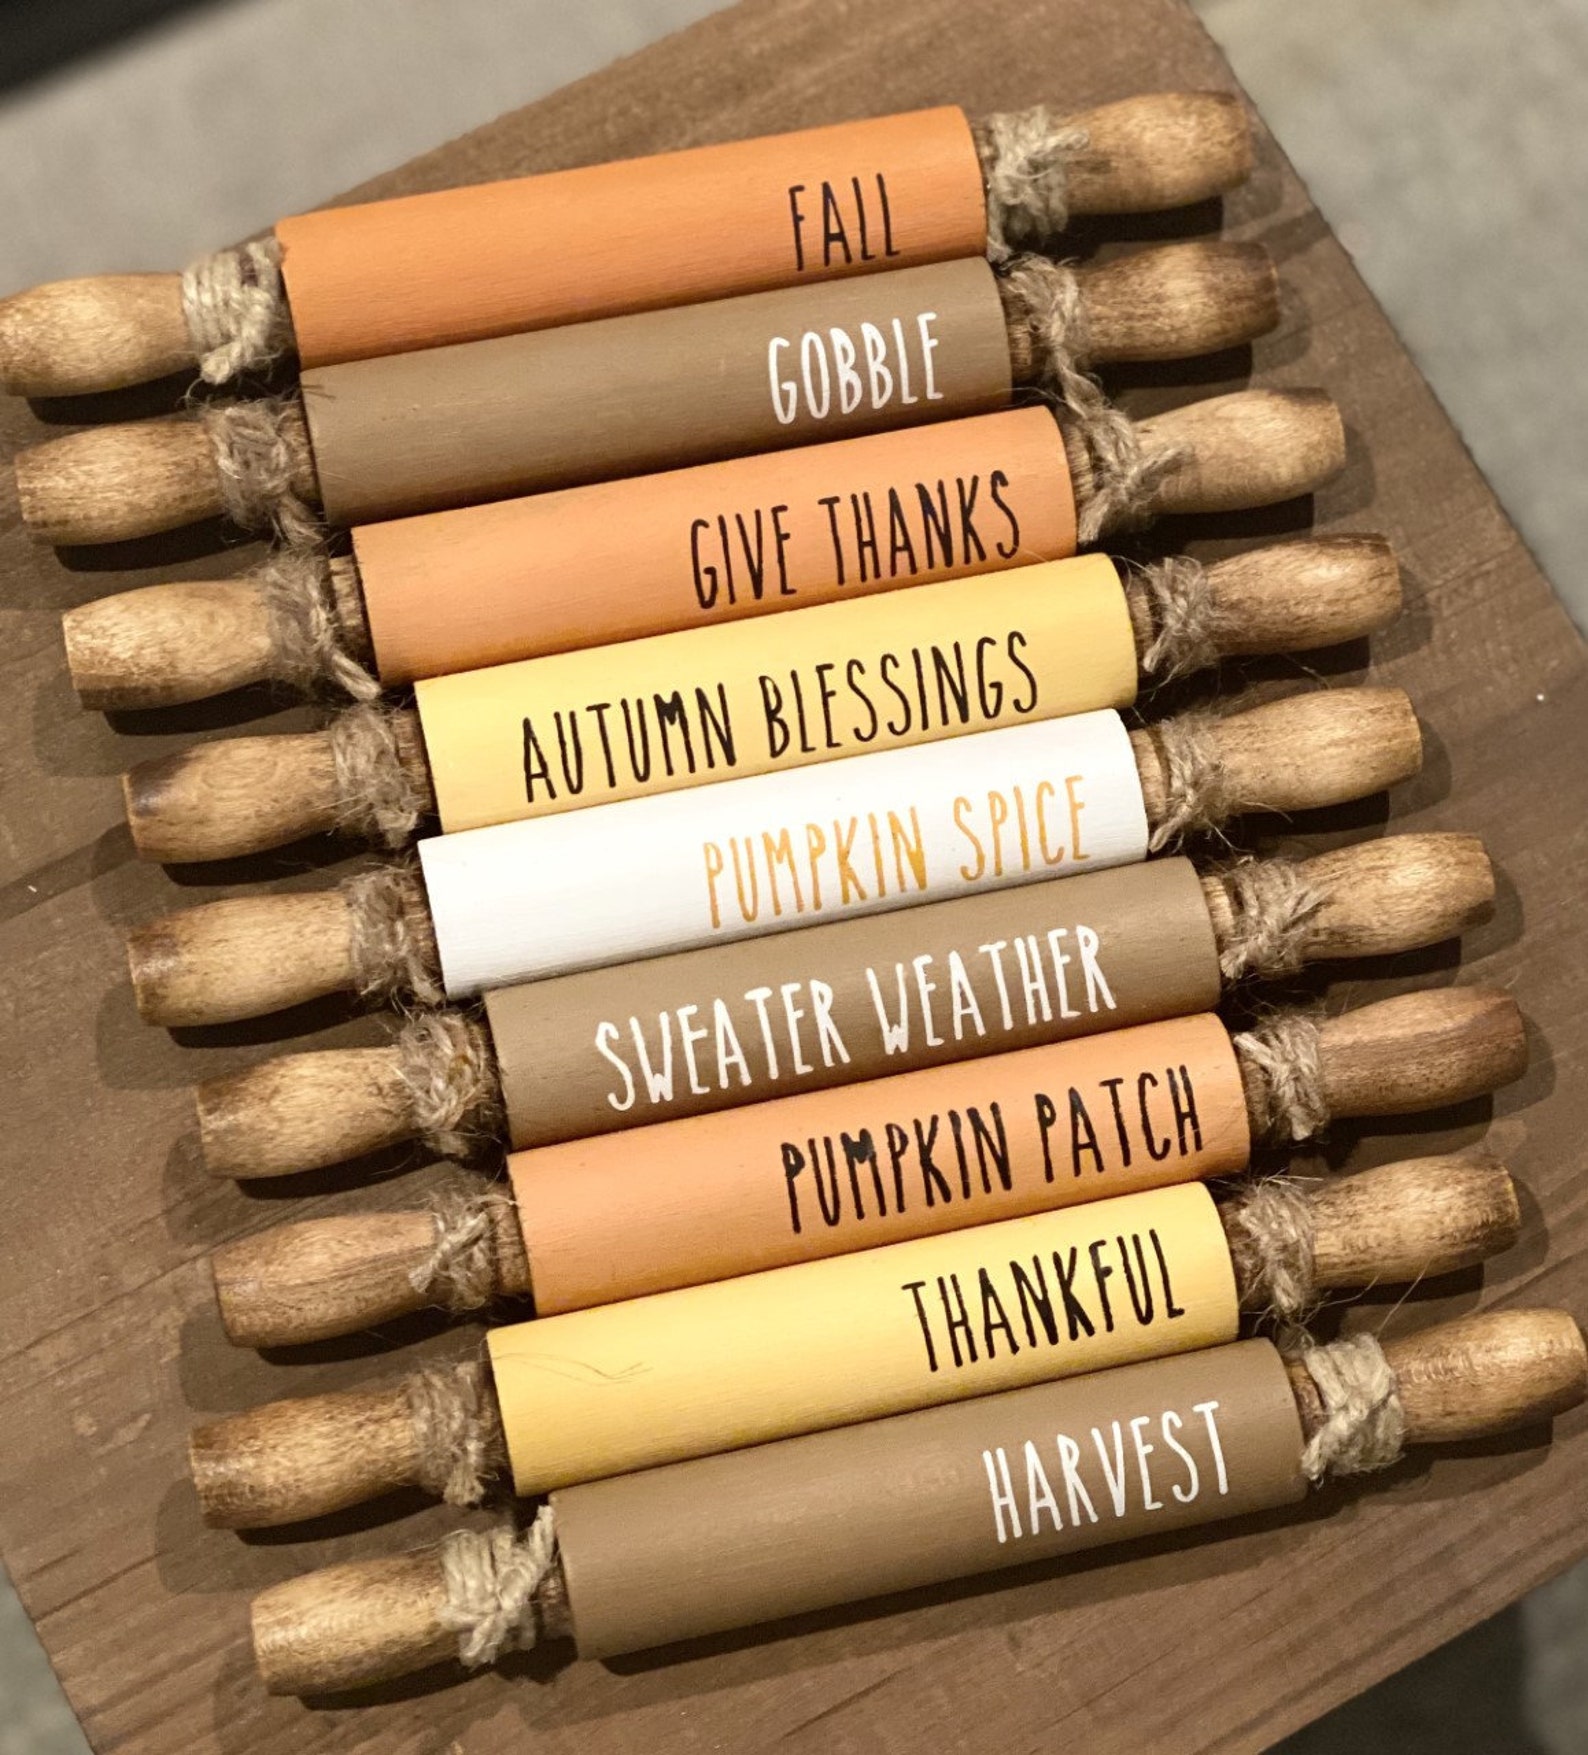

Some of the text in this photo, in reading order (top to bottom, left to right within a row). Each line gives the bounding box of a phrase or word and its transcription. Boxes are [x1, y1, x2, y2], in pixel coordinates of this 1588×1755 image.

[788, 173, 900, 271] FALL
[768, 311, 944, 424] GOBBLE
[689, 469, 1020, 609] GIVE THANKS
[521, 631, 1038, 802] AUTUMN BLESSINGS
[703, 775, 1089, 928] PUMPKIN SPICE
[594, 925, 1117, 1111] SWEATER WEATHER
[780, 1065, 1204, 1233] PUMPKIN PATCH
[902, 1229, 1185, 1372] THANKFUL
[982, 1401, 1229, 1543] HARVEST
